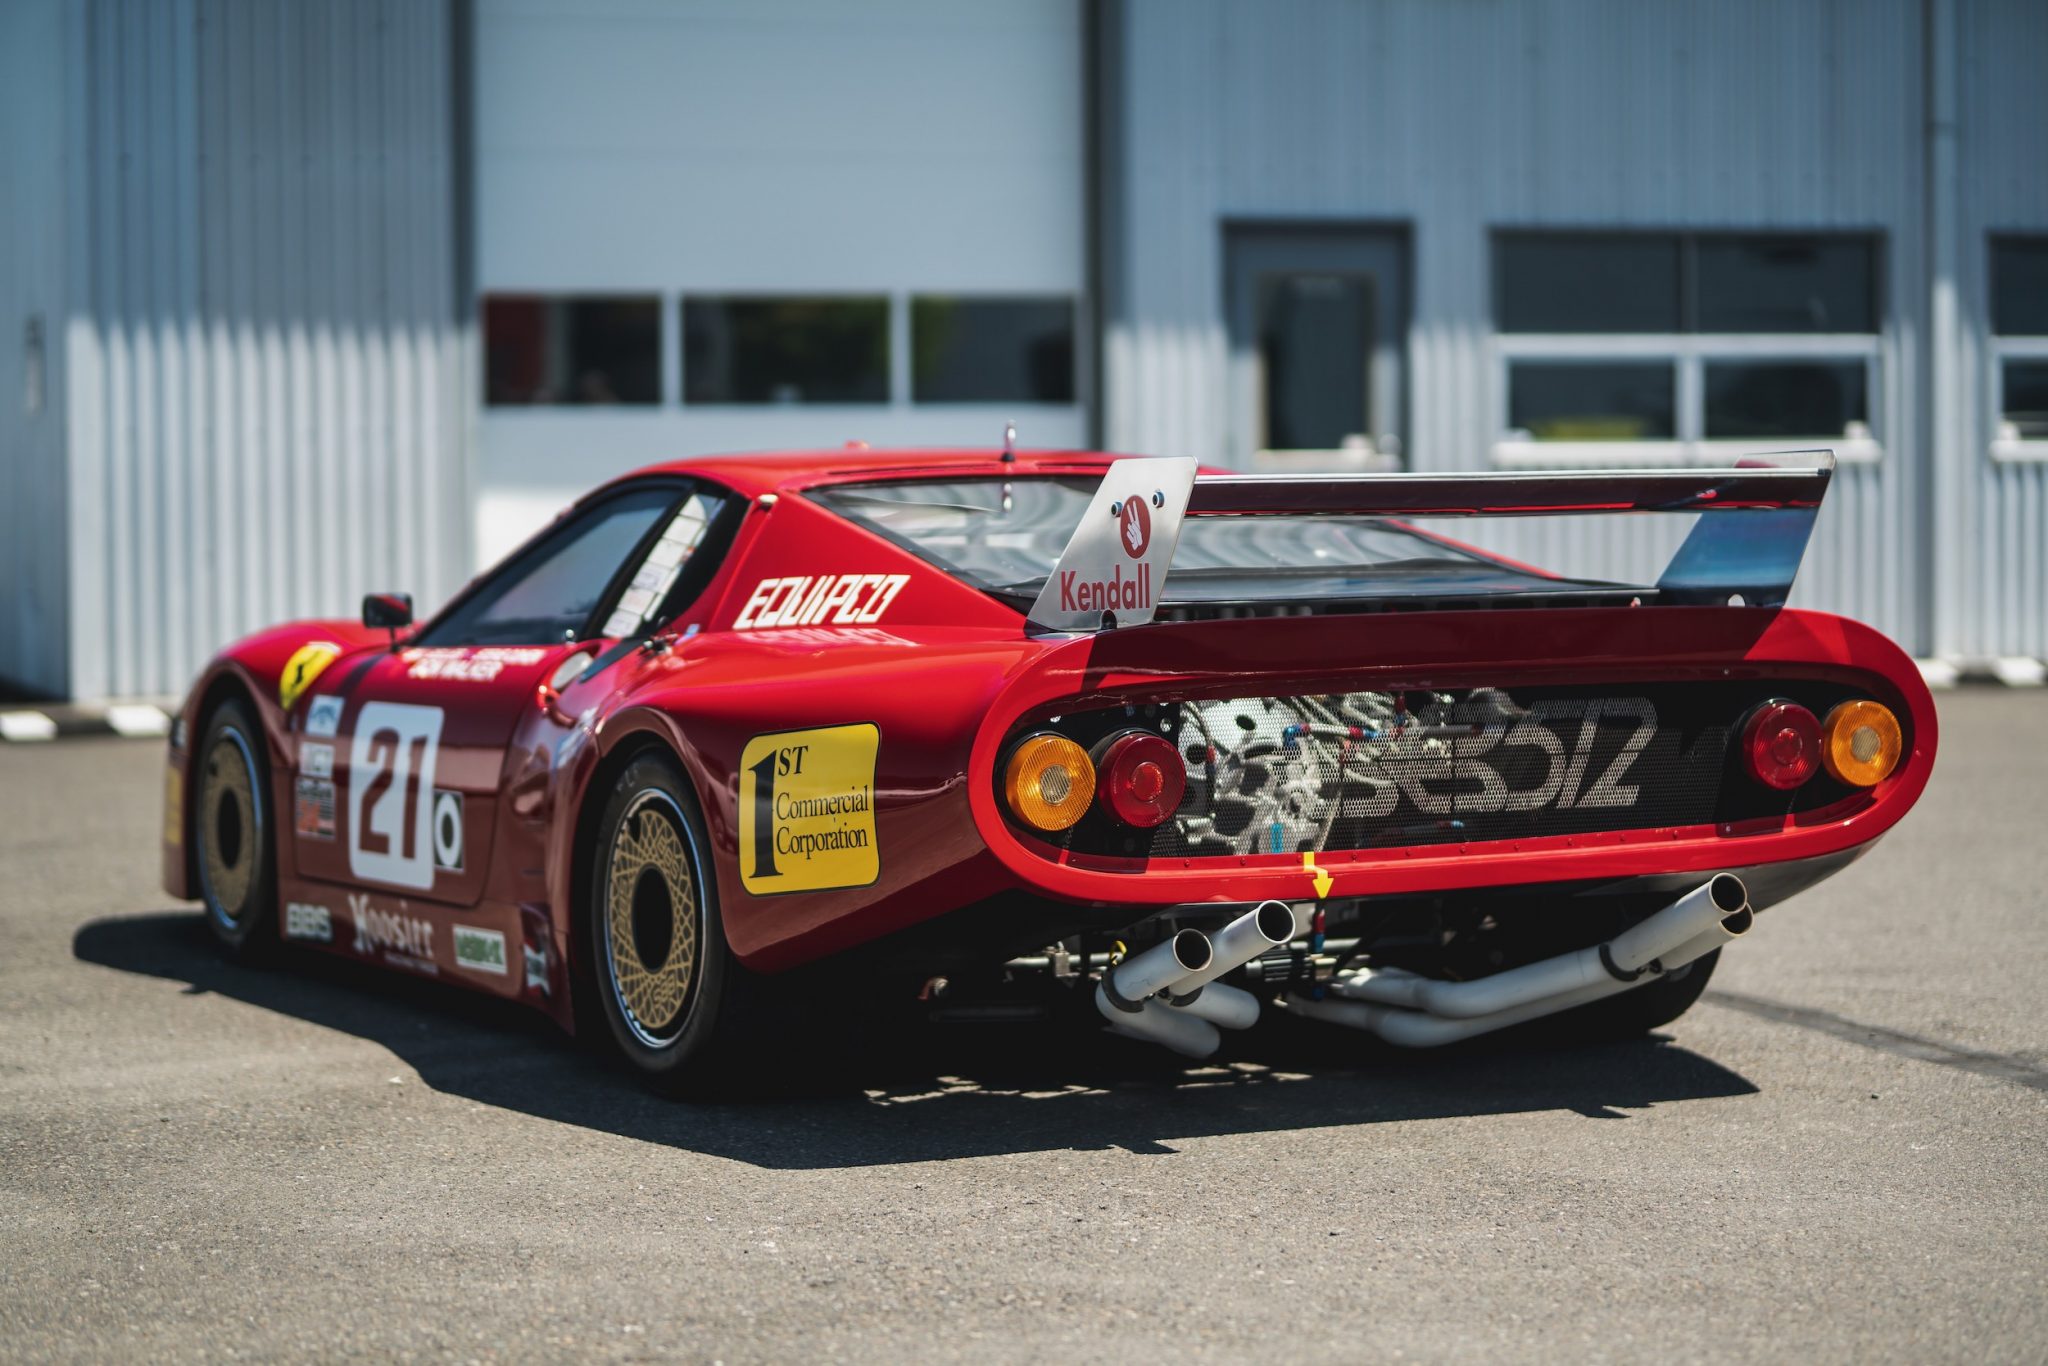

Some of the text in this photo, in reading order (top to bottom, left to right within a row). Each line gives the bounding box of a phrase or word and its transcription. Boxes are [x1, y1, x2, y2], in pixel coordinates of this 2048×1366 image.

[732, 574, 911, 630] EQUIPCO
[1060, 562, 1152, 612] Kendall
[359, 726, 428, 860] 21
[776, 785, 869, 821] Commercial
[776, 822, 869, 860] Corporation
[286, 901, 333, 942] BBS
